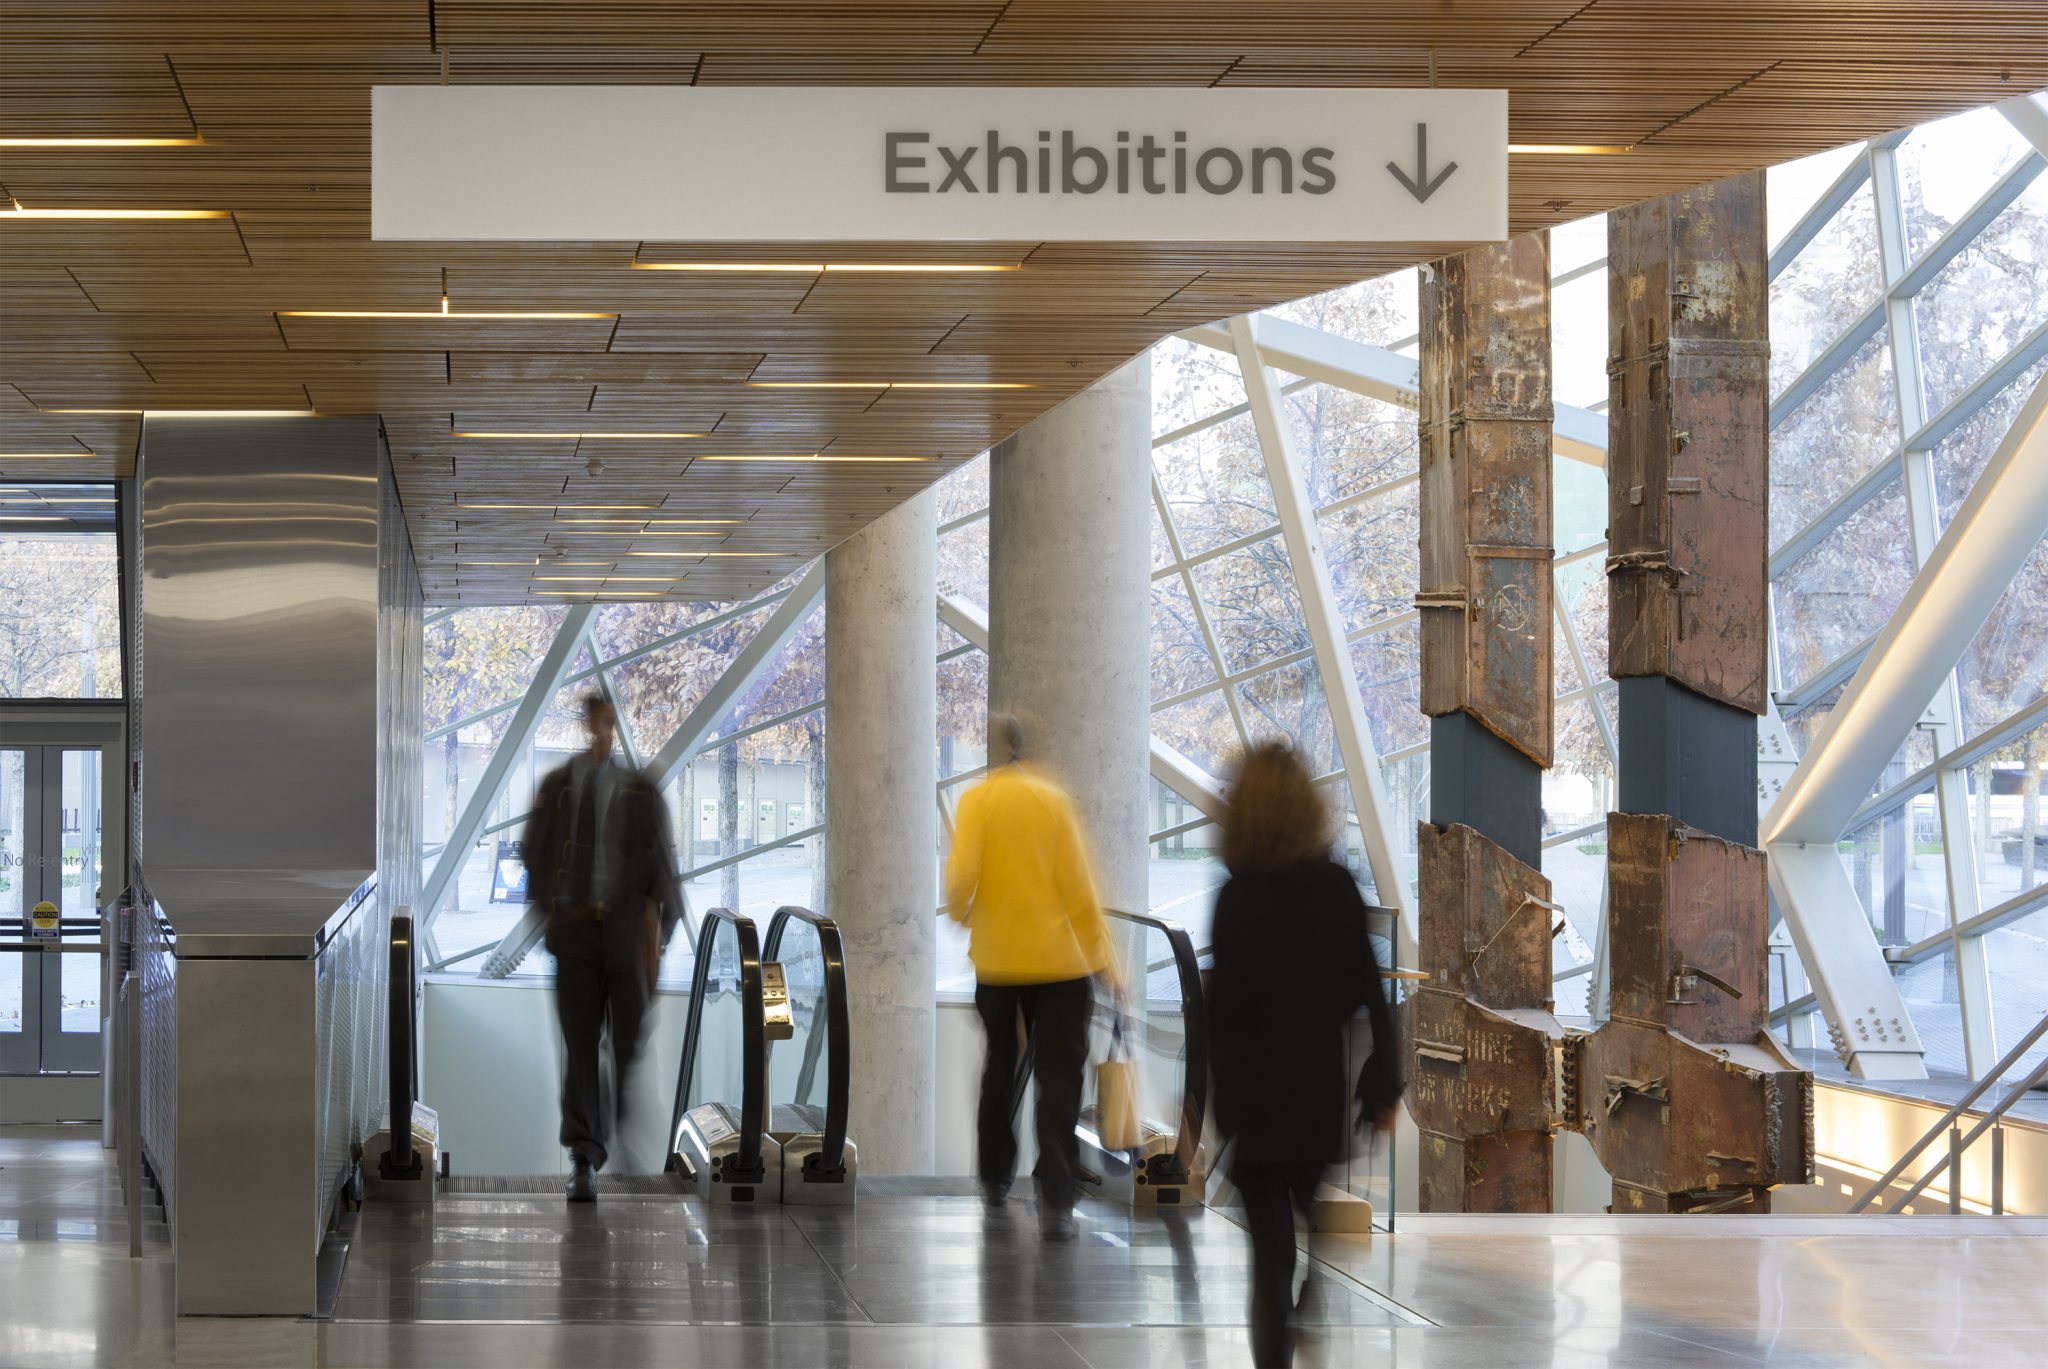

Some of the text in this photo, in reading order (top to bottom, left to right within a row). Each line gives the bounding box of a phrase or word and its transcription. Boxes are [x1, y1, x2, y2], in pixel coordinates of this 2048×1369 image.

[885, 130, 1336, 195] Exhibitions
[4, 853, 89, 870] No Re-entry
